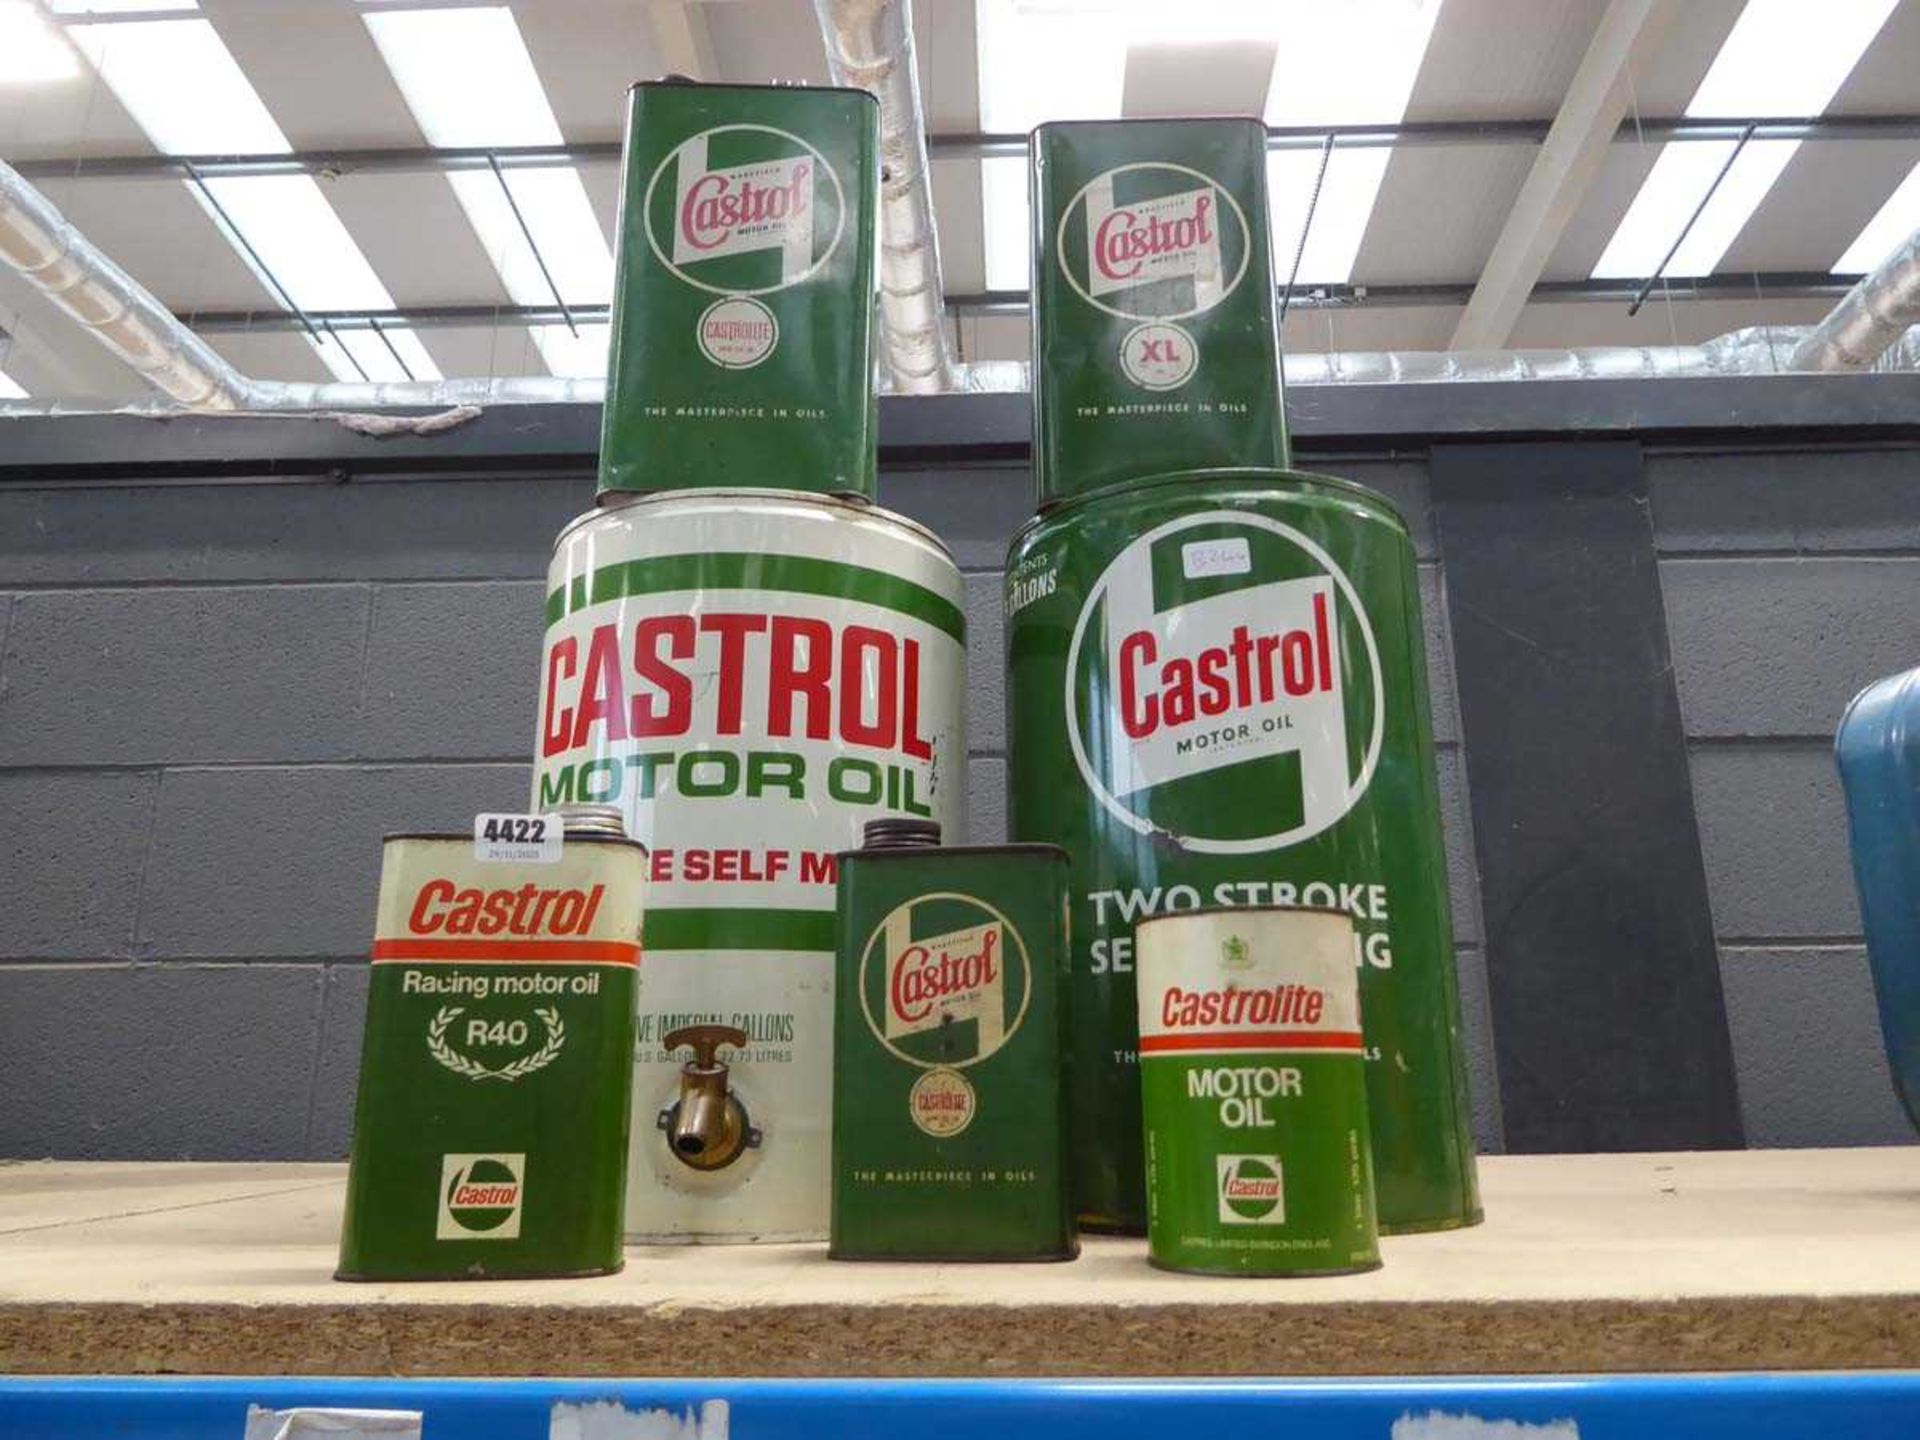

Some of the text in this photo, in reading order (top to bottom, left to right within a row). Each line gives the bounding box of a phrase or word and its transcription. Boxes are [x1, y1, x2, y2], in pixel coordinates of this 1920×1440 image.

[682, 164, 809, 250] Castrol
[1095, 196, 1212, 280] Castrol
[1140, 339, 1180, 363] XL
[645, 407, 667, 417] THE
[774, 408, 787, 418] IN
[796, 408, 825, 419] OILS
[1077, 402, 1247, 417] THE MASTERPIECE IN OILS
[1119, 592, 1332, 740] Castrol
[543, 614, 932, 761] CASTROL
[1176, 724, 1250, 754] MOTOR
[1262, 714, 1294, 733] OIL
[541, 750, 932, 817] MOTOR OIL
[483, 819, 546, 843] 4422
[683, 849, 789, 882] SELF
[408, 879, 606, 937] Castrol
[1088, 882, 1389, 926] TWO STROKE
[403, 969, 600, 997] Racing motor oil
[892, 930, 998, 1022] Castrol
[1162, 984, 1325, 1028] Castrolite
[466, 1019, 529, 1047] R40
[1114, 1051, 1138, 1063] TH
[1187, 1066, 1303, 1099] MOTOR
[1219, 1098, 1277, 1129] OIL
[854, 1170, 1035, 1181] THE MASTERPIECE IN OILS
[1228, 1179, 1280, 1196] Castrol
[454, 1184, 519, 1207] Castrol
